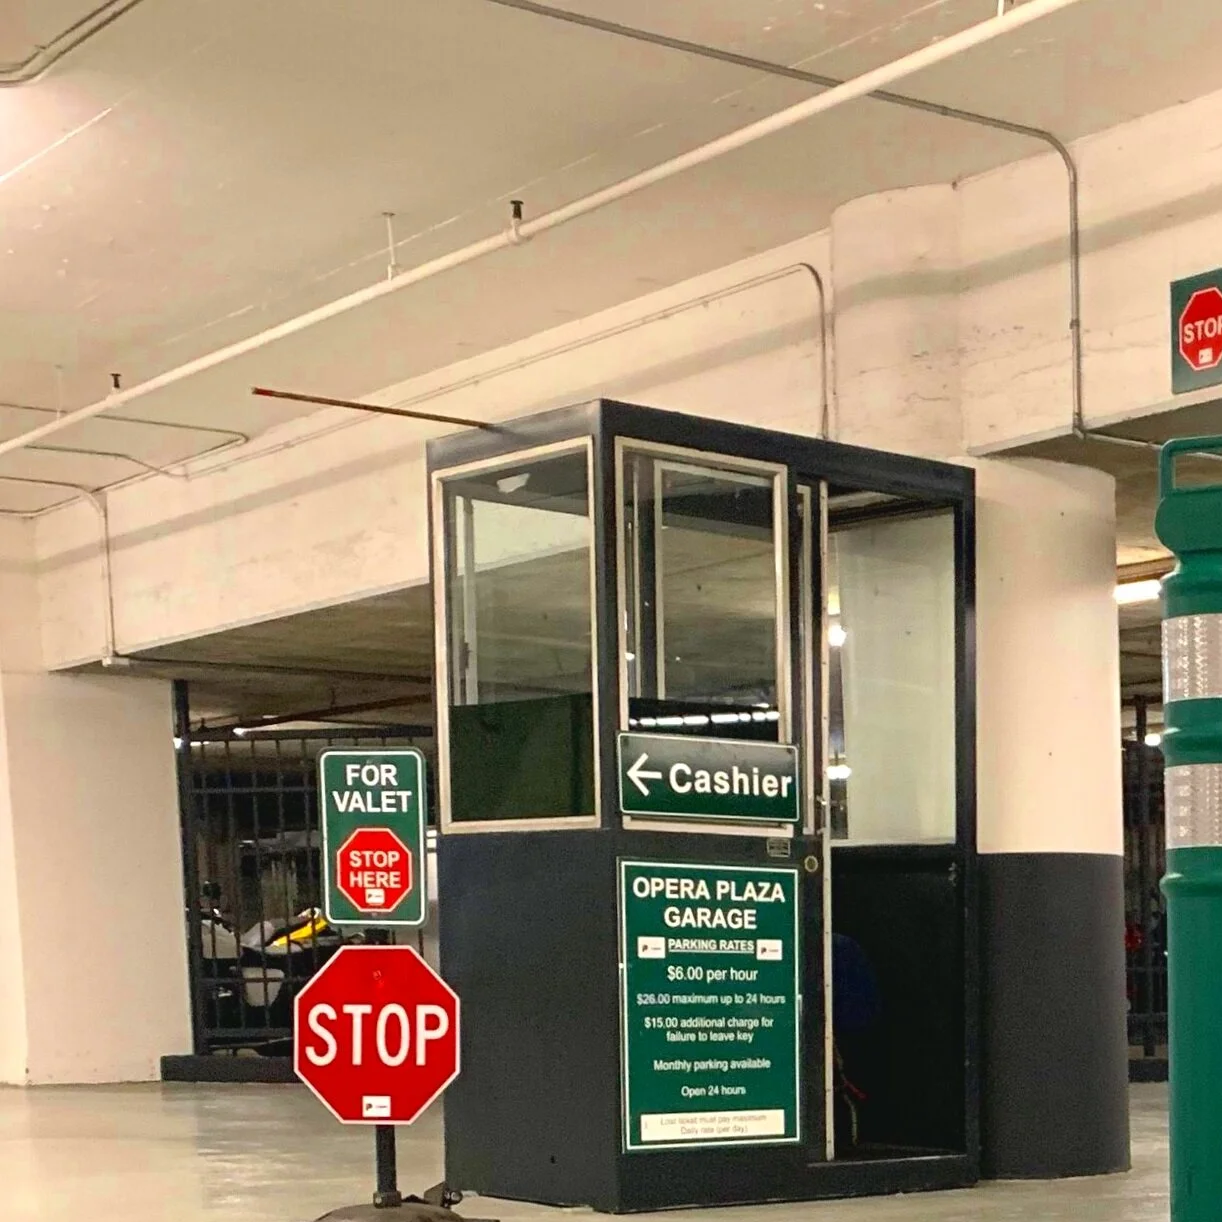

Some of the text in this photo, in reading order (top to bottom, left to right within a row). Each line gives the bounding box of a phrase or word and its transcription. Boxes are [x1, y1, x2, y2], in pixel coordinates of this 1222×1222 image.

[345, 763, 398, 787] FOR
[669, 763, 793, 797] Cashier
[332, 790, 412, 813] VALET
[349, 850, 400, 868] STOP
[349, 871, 402, 888] HERE
[632, 876, 786, 903] OPERA PLAZA
[663, 906, 757, 929] GARAGE
[667, 938, 717, 950] PARKING
[719, 940, 755, 951] RATES
[667, 965, 758, 983] $6.00 per hour
[672, 994, 718, 1004] maximum
[720, 996, 733, 1005] up
[734, 994, 744, 1004] to
[745, 994, 757, 1003] 24
[760, 994, 786, 1004] hours
[680, 1017, 725, 1028] additional
[727, 1017, 759, 1029] charge
[761, 1017, 774, 1027] for
[305, 1003, 449, 1067] STOP
[666, 1031, 754, 1043] failure to leave key
[653, 1058, 771, 1072] Monthly parking available
[681, 1085, 747, 1098] Open 24 hours
